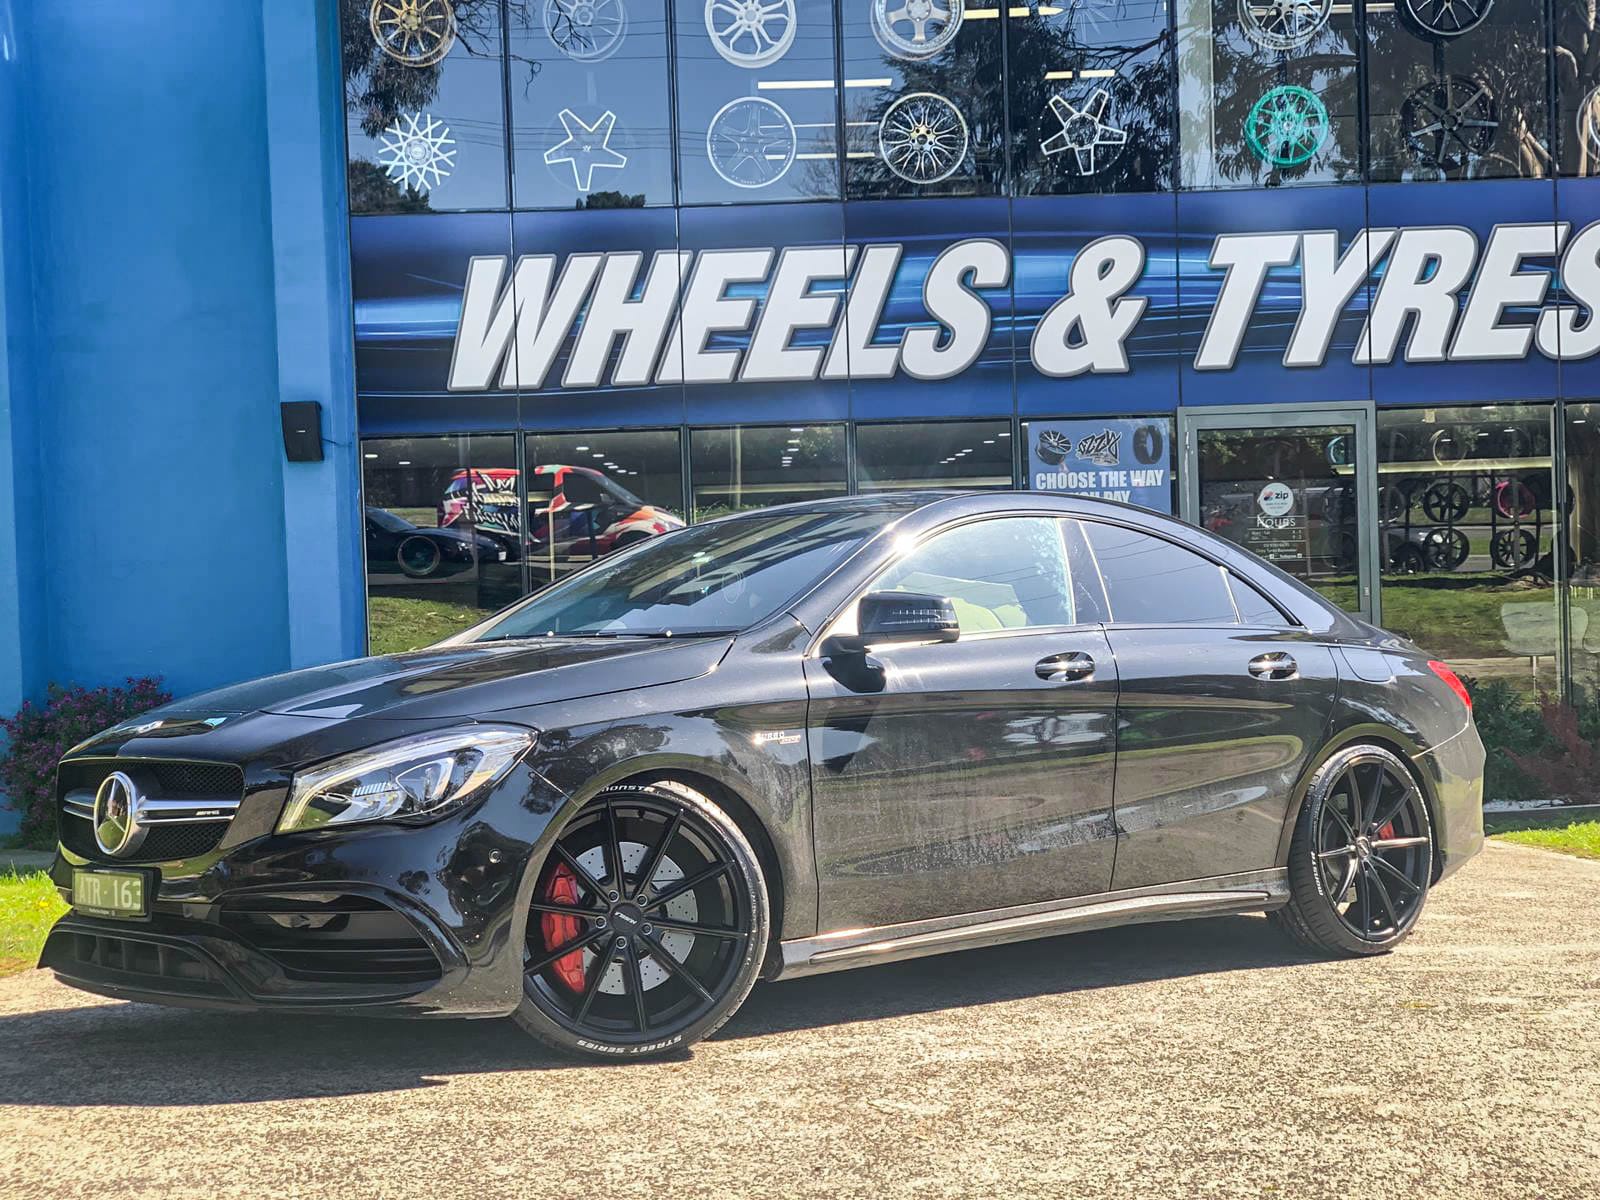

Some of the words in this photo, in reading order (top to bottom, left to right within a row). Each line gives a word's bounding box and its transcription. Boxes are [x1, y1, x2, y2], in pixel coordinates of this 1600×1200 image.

[447, 238, 1011, 391] WHEELS
[1030, 234, 1148, 377] &
[1035, 472, 1097, 490] CHOOSE
[1099, 471, 1127, 488] THE
[1129, 469, 1164, 487] WAY
[1275, 491, 1289, 500] zip
[577, 1039, 626, 1054] SERIES
[630, 1034, 683, 1054] STREET
